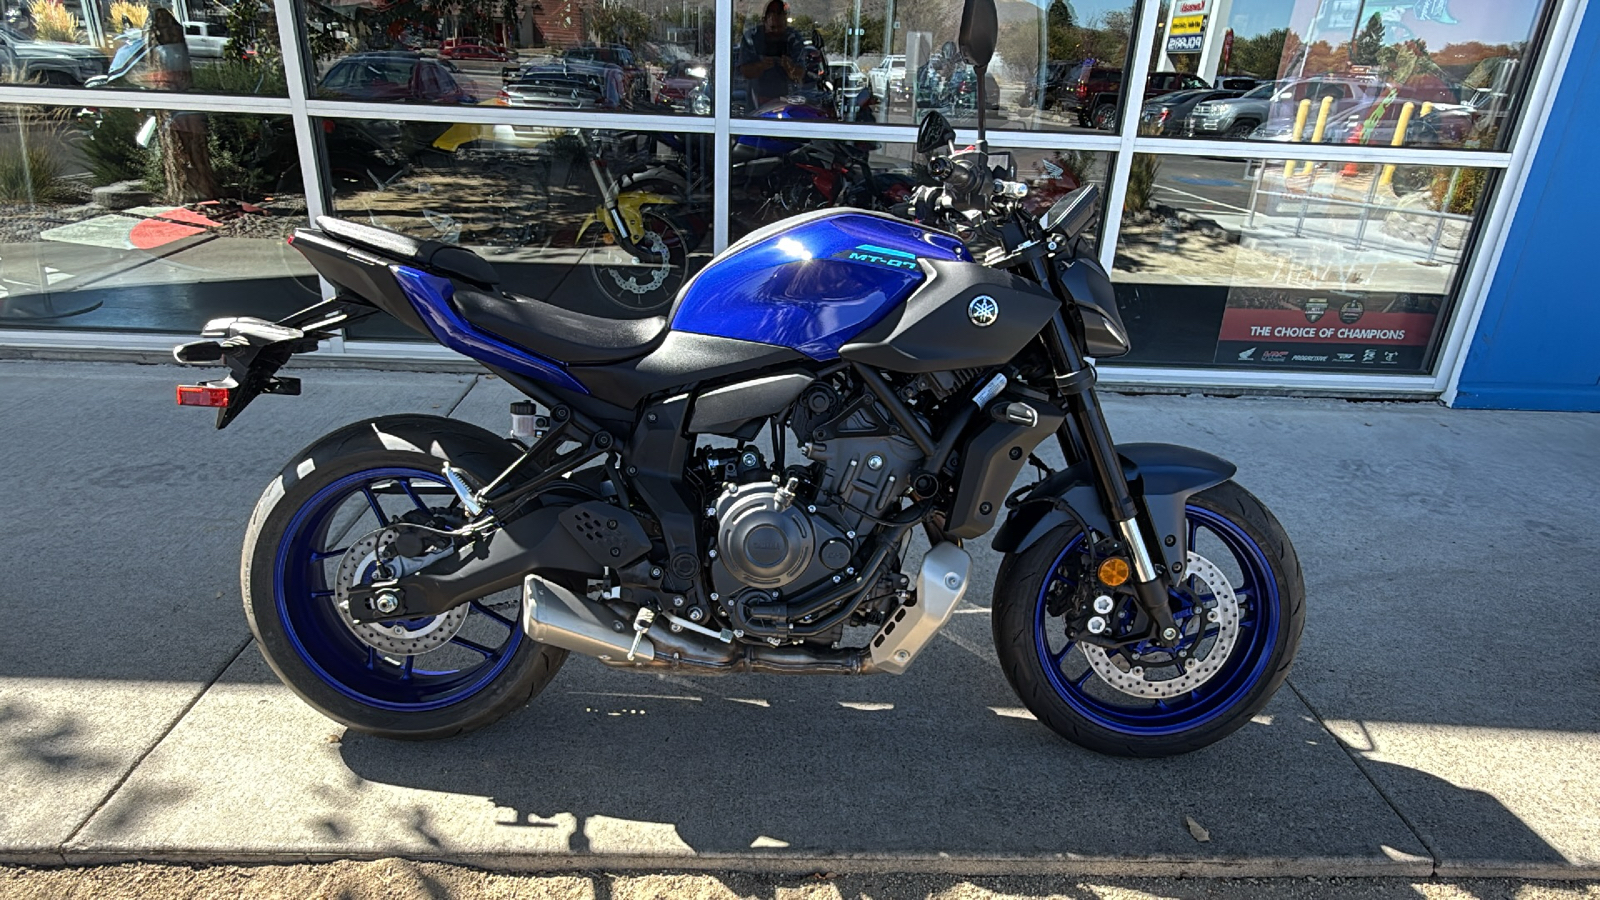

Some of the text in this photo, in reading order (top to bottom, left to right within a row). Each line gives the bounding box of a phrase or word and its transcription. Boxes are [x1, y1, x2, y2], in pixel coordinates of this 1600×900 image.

[849, 253, 916, 269] MT-07
[1250, 326, 1405, 340] THE CHOICE OF CHAMPIONS
